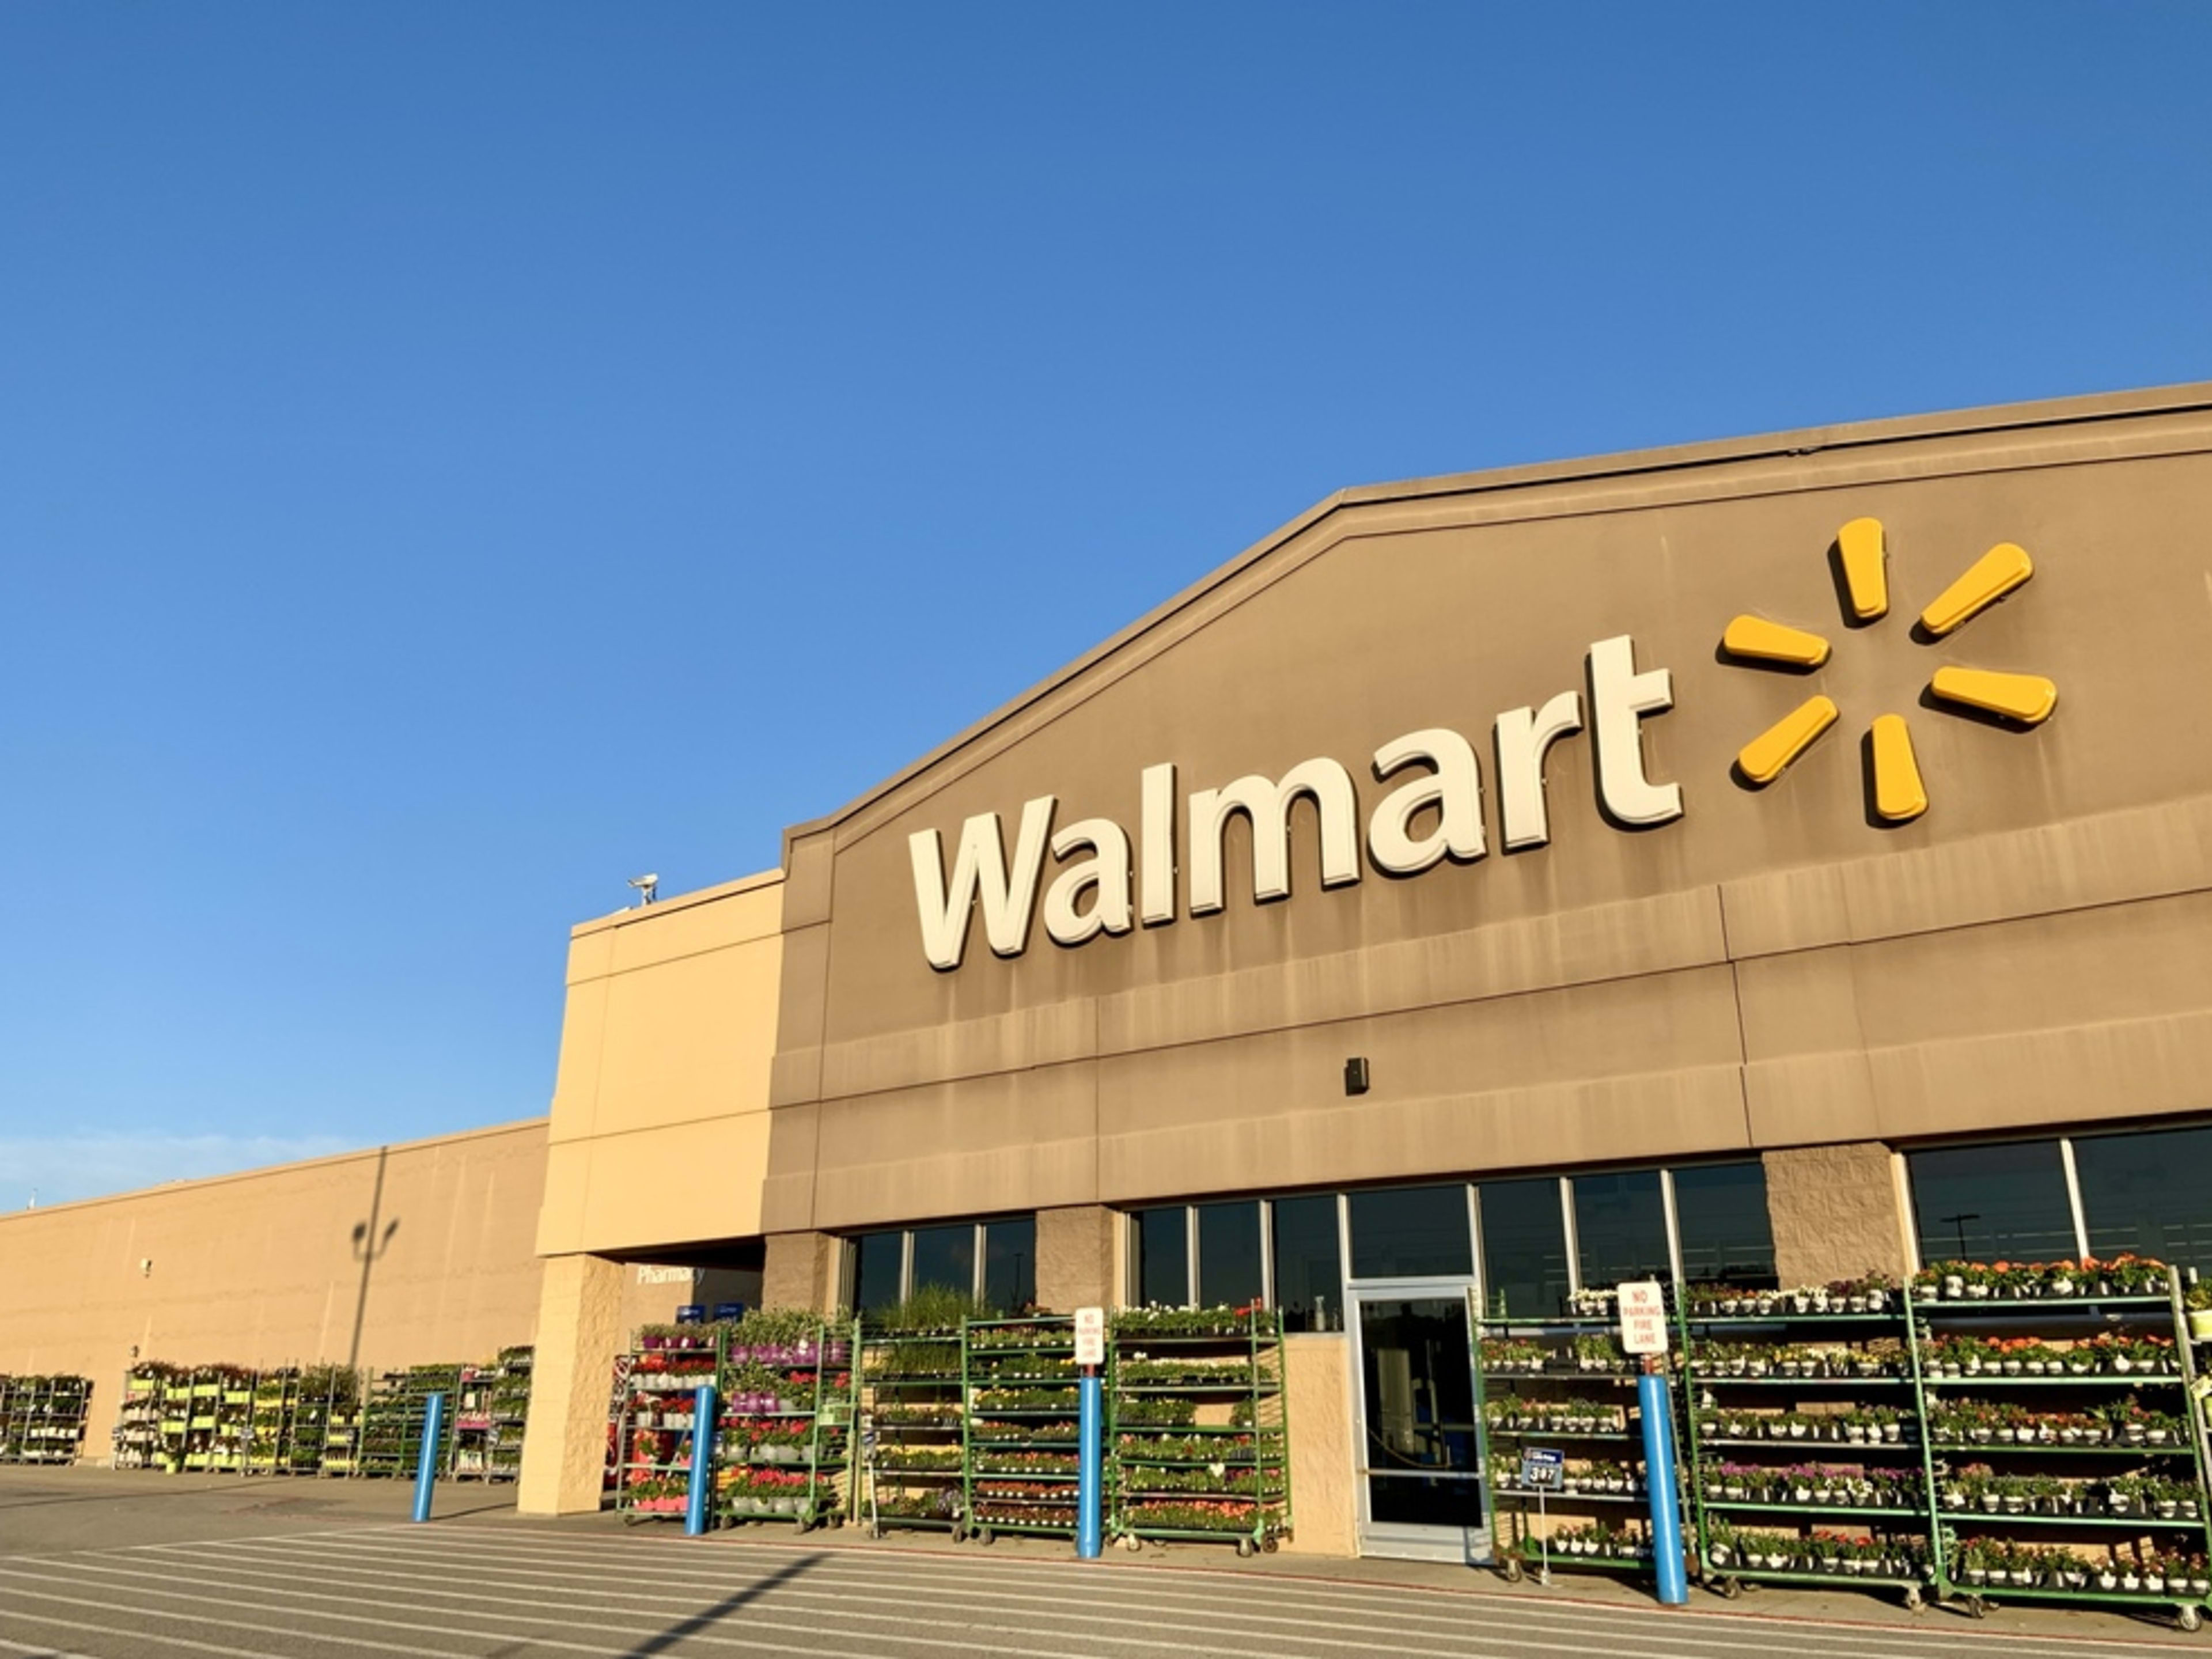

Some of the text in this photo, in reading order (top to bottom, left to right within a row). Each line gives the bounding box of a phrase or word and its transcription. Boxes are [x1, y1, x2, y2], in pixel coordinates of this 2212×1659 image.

[908, 634, 1684, 971] Walmart
[1632, 1290, 1648, 1304] NO
[1623, 1305, 1661, 1316] PARKING
[1633, 1319, 1653, 1331] FIRE
[1634, 1333, 1656, 1344] LANE
